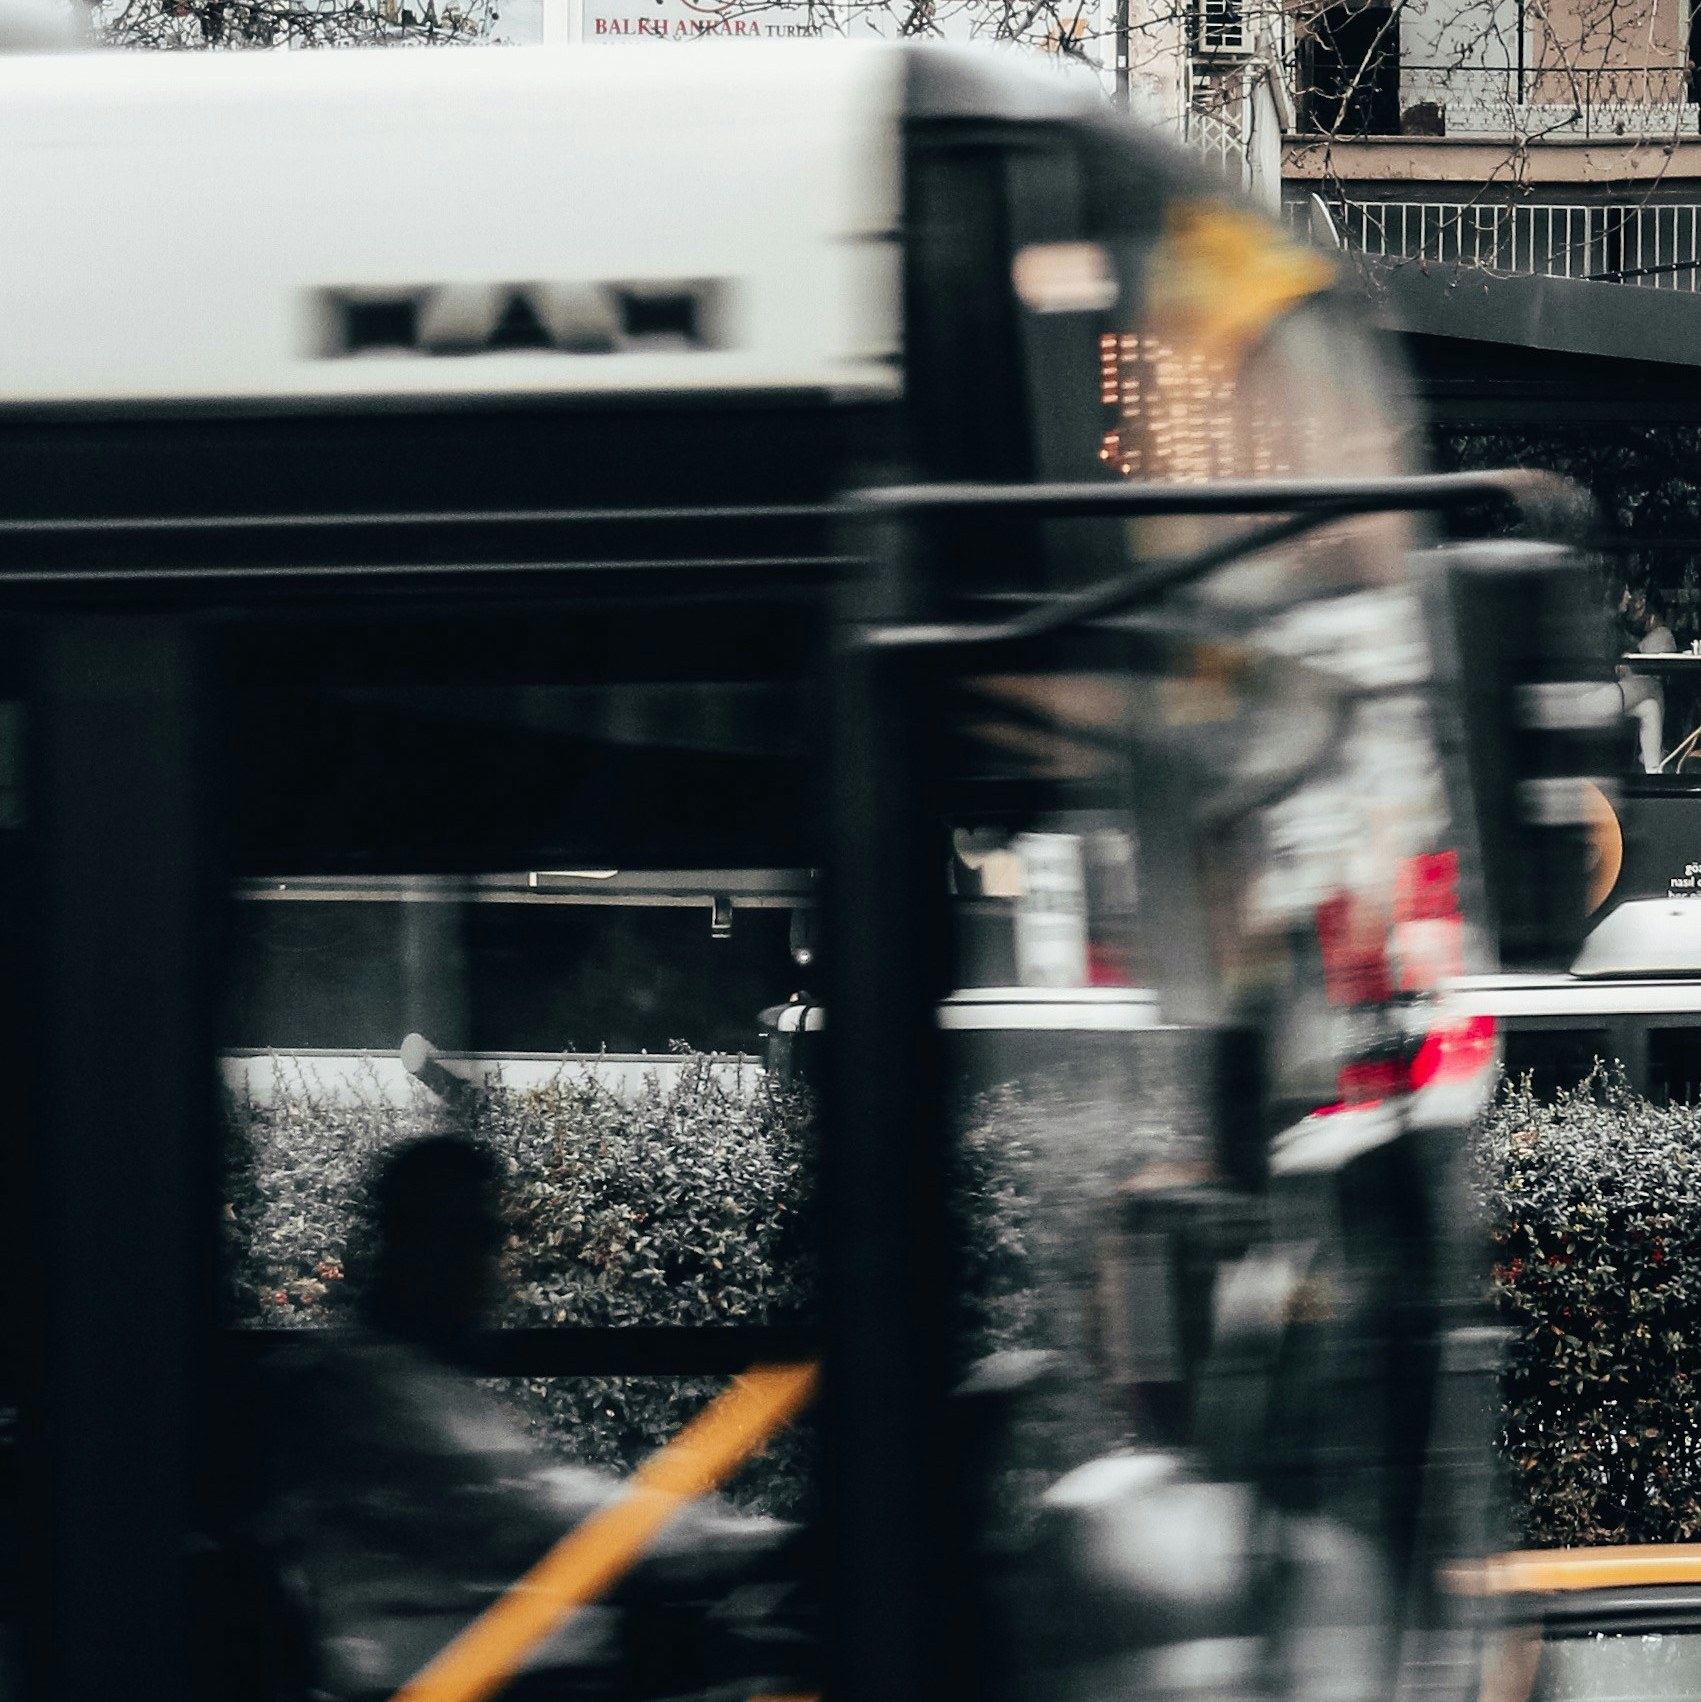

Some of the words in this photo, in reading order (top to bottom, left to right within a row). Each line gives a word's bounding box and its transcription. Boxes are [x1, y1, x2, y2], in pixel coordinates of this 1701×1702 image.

[595, 18, 669, 37] BALKH
[675, 19, 761, 37] ANKARA
[1671, 876, 1695, 888] nasıl
